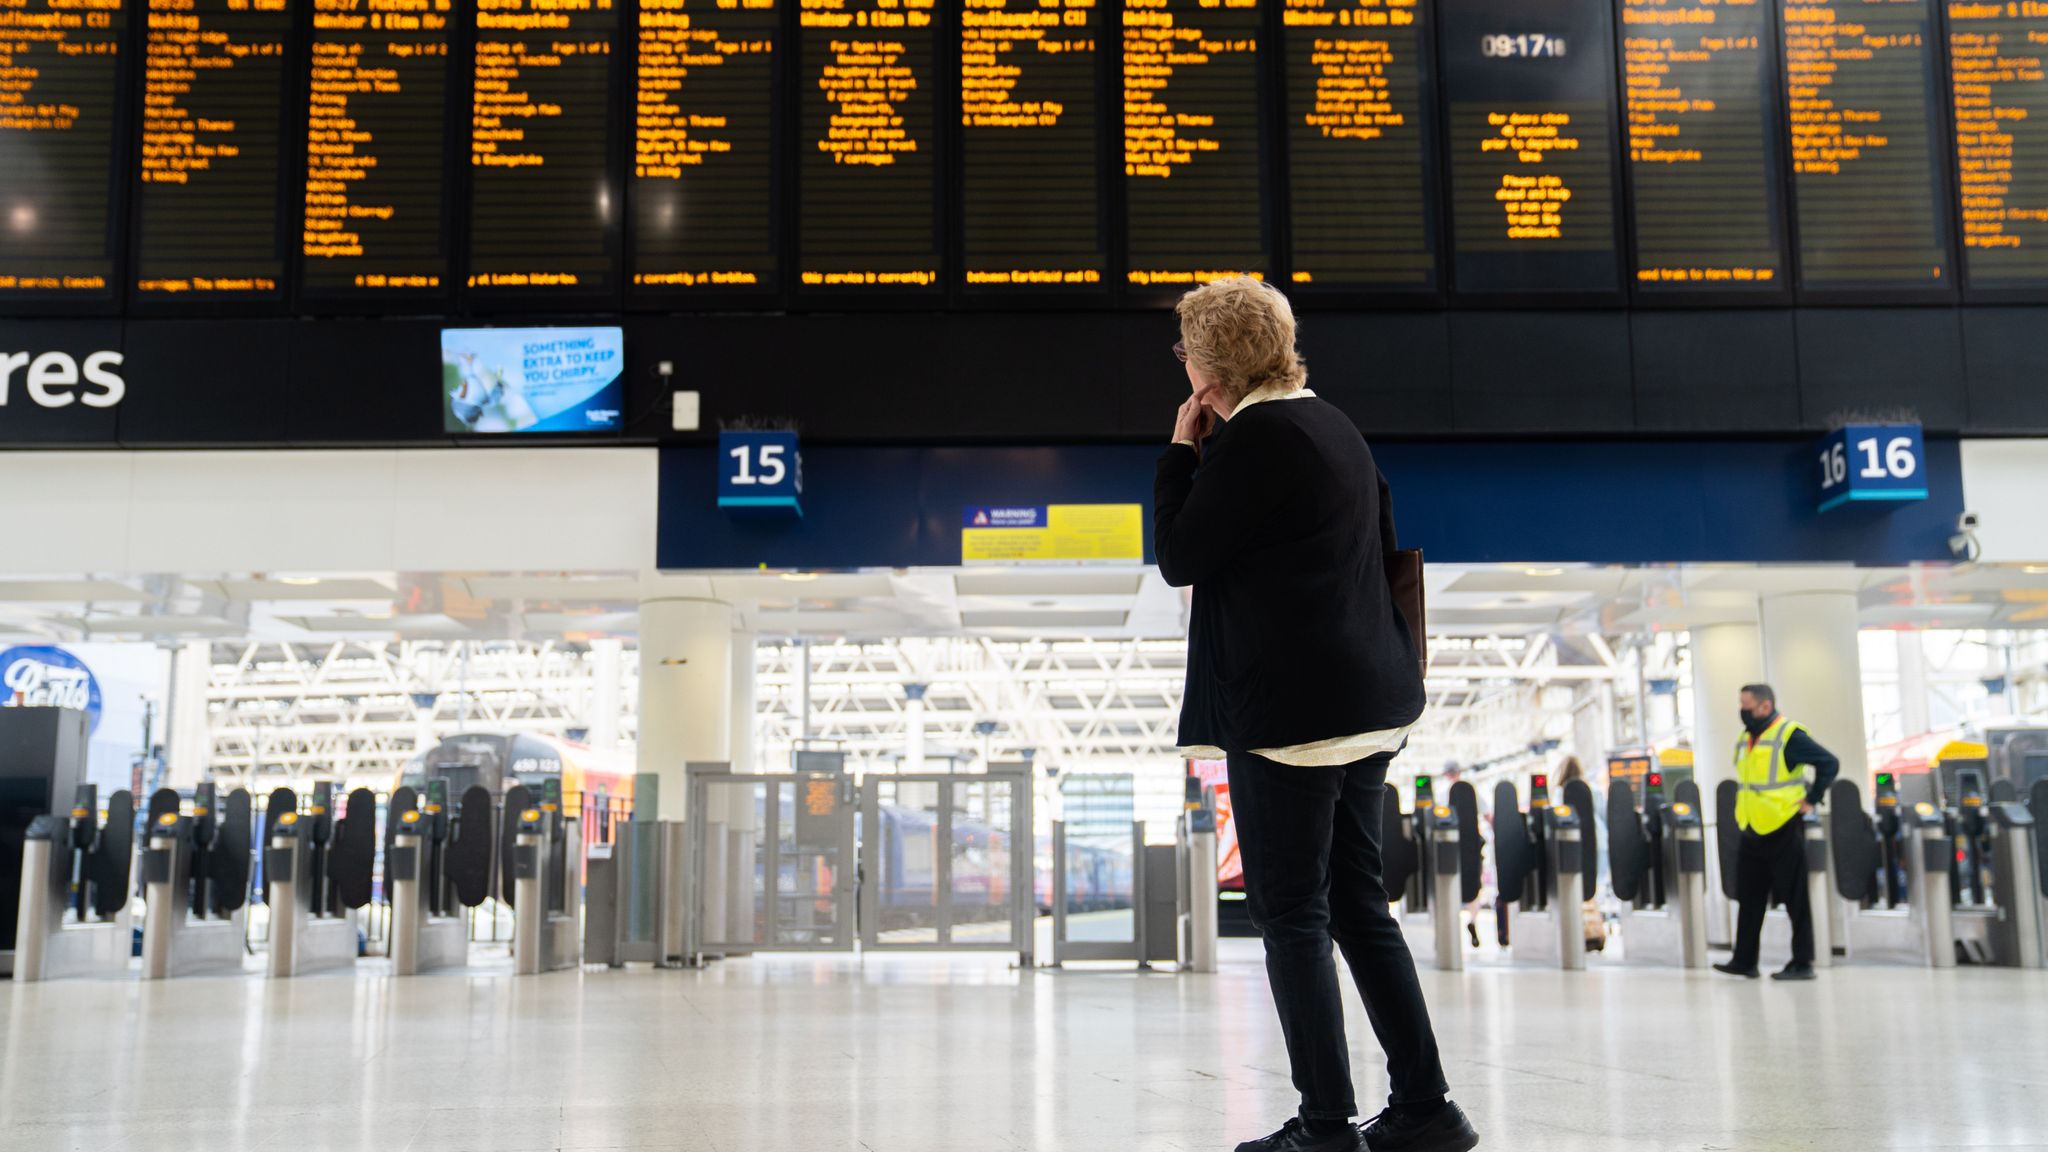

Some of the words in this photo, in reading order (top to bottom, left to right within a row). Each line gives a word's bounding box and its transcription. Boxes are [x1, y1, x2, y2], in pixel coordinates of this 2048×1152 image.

[523, 338, 595, 355] SOMETHING
[523, 354, 563, 369] EXTRA
[566, 352, 584, 365] TO
[585, 350, 614, 363] KEEP
[0, 350, 126, 408] res
[524, 369, 550, 381] YOU
[730, 444, 786, 485] 15
[1819, 441, 1847, 489] 16
[1857, 436, 1917, 478] 16
[990, 508, 1037, 519] WARNING
